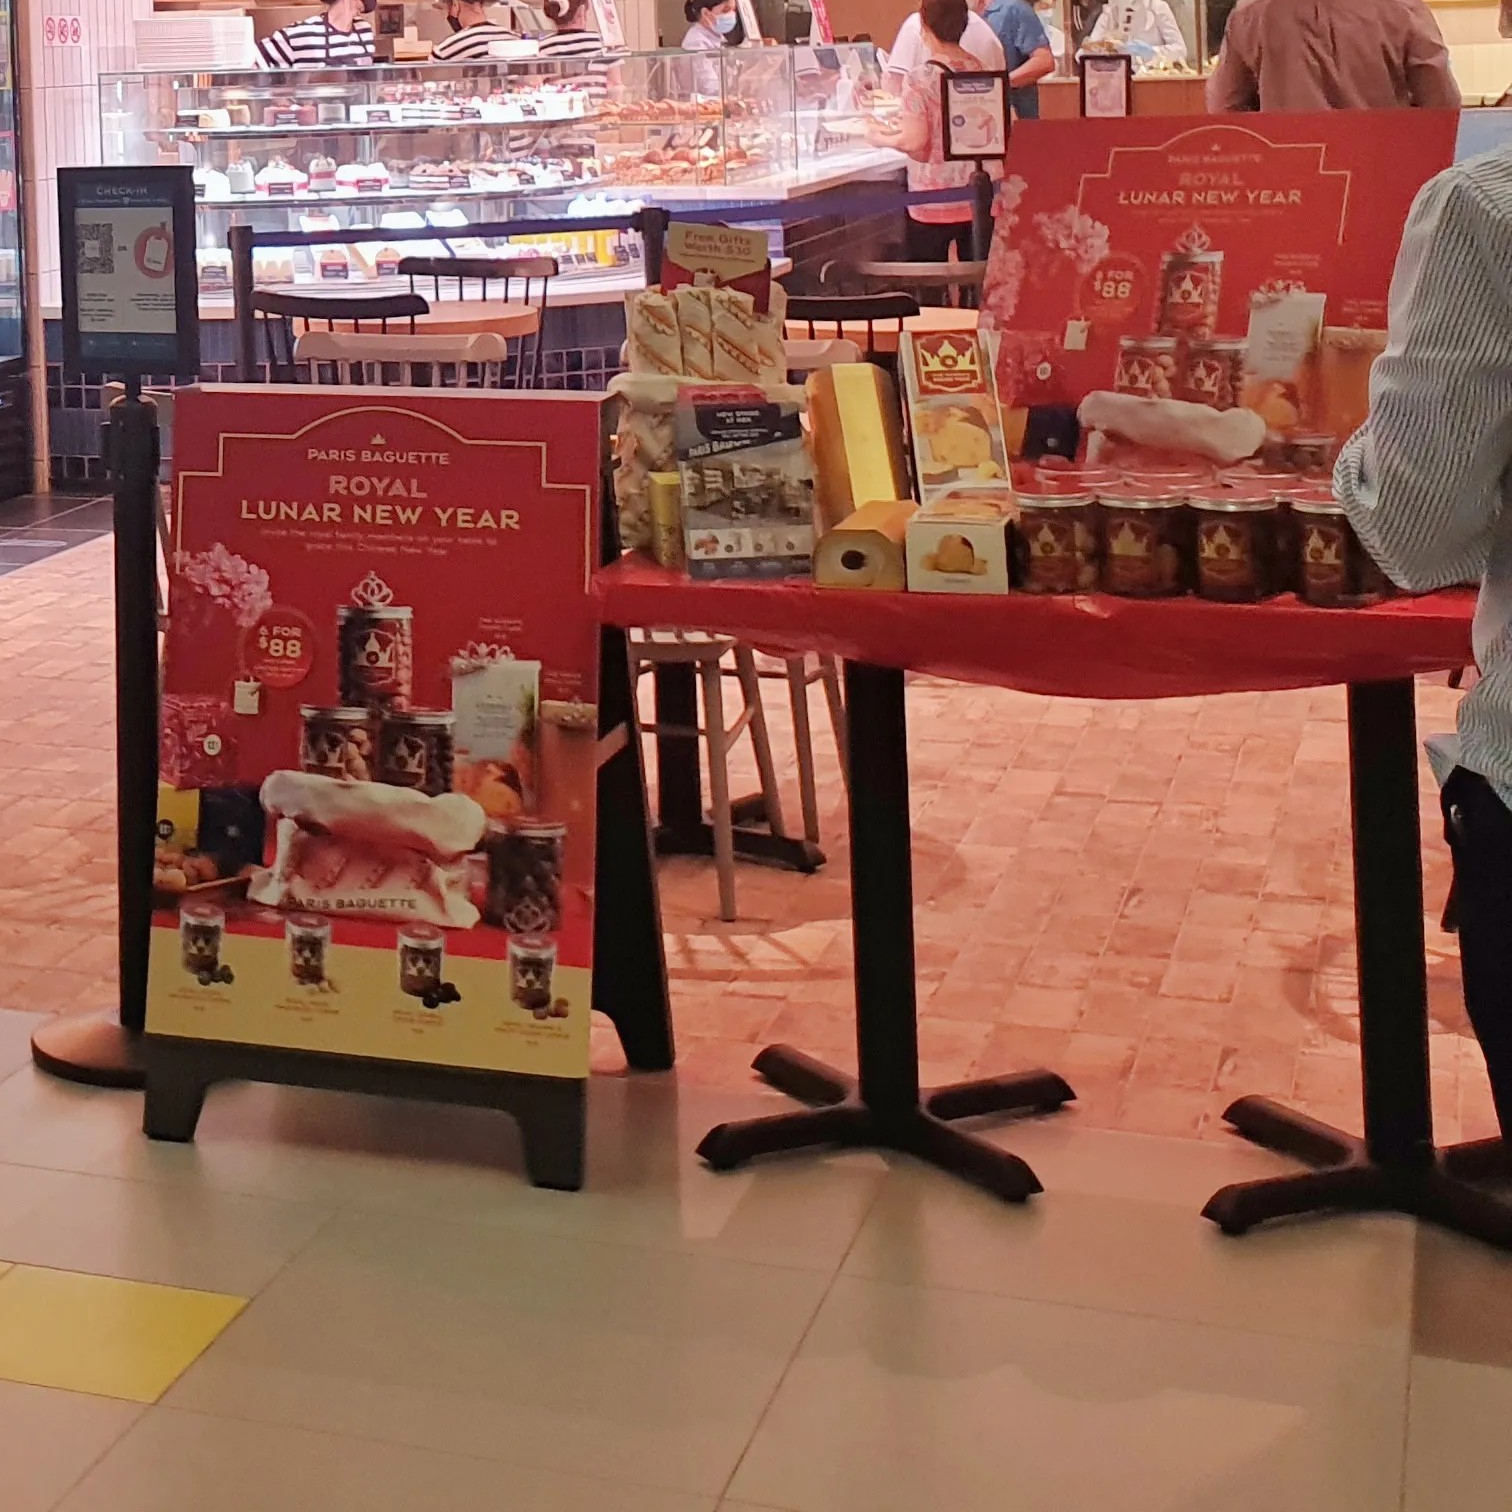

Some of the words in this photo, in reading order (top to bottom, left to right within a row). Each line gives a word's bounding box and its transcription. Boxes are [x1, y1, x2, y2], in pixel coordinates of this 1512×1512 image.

[1178, 171, 1244, 187] ROYAL
[96, 186, 148, 196] CHECK-IN
[1117, 189, 1185, 206] LUNAR
[1192, 189, 1239, 206] NEW
[1246, 189, 1303, 206] YEAR
[685, 230, 714, 242] Free
[719, 233, 752, 245] Gifts
[307, 448, 356, 463] PARIS
[361, 450, 450, 466] BAGUETTE
[329, 475, 428, 499] ROYAL
[240, 499, 343, 524] LUNAR
[353, 504, 424, 526] NEW
[433, 506, 521, 530] YEAR
[272, 626, 302, 637] FOR
[258, 637, 302, 658] $88
[335, 898, 417, 910] BAGUETTE
